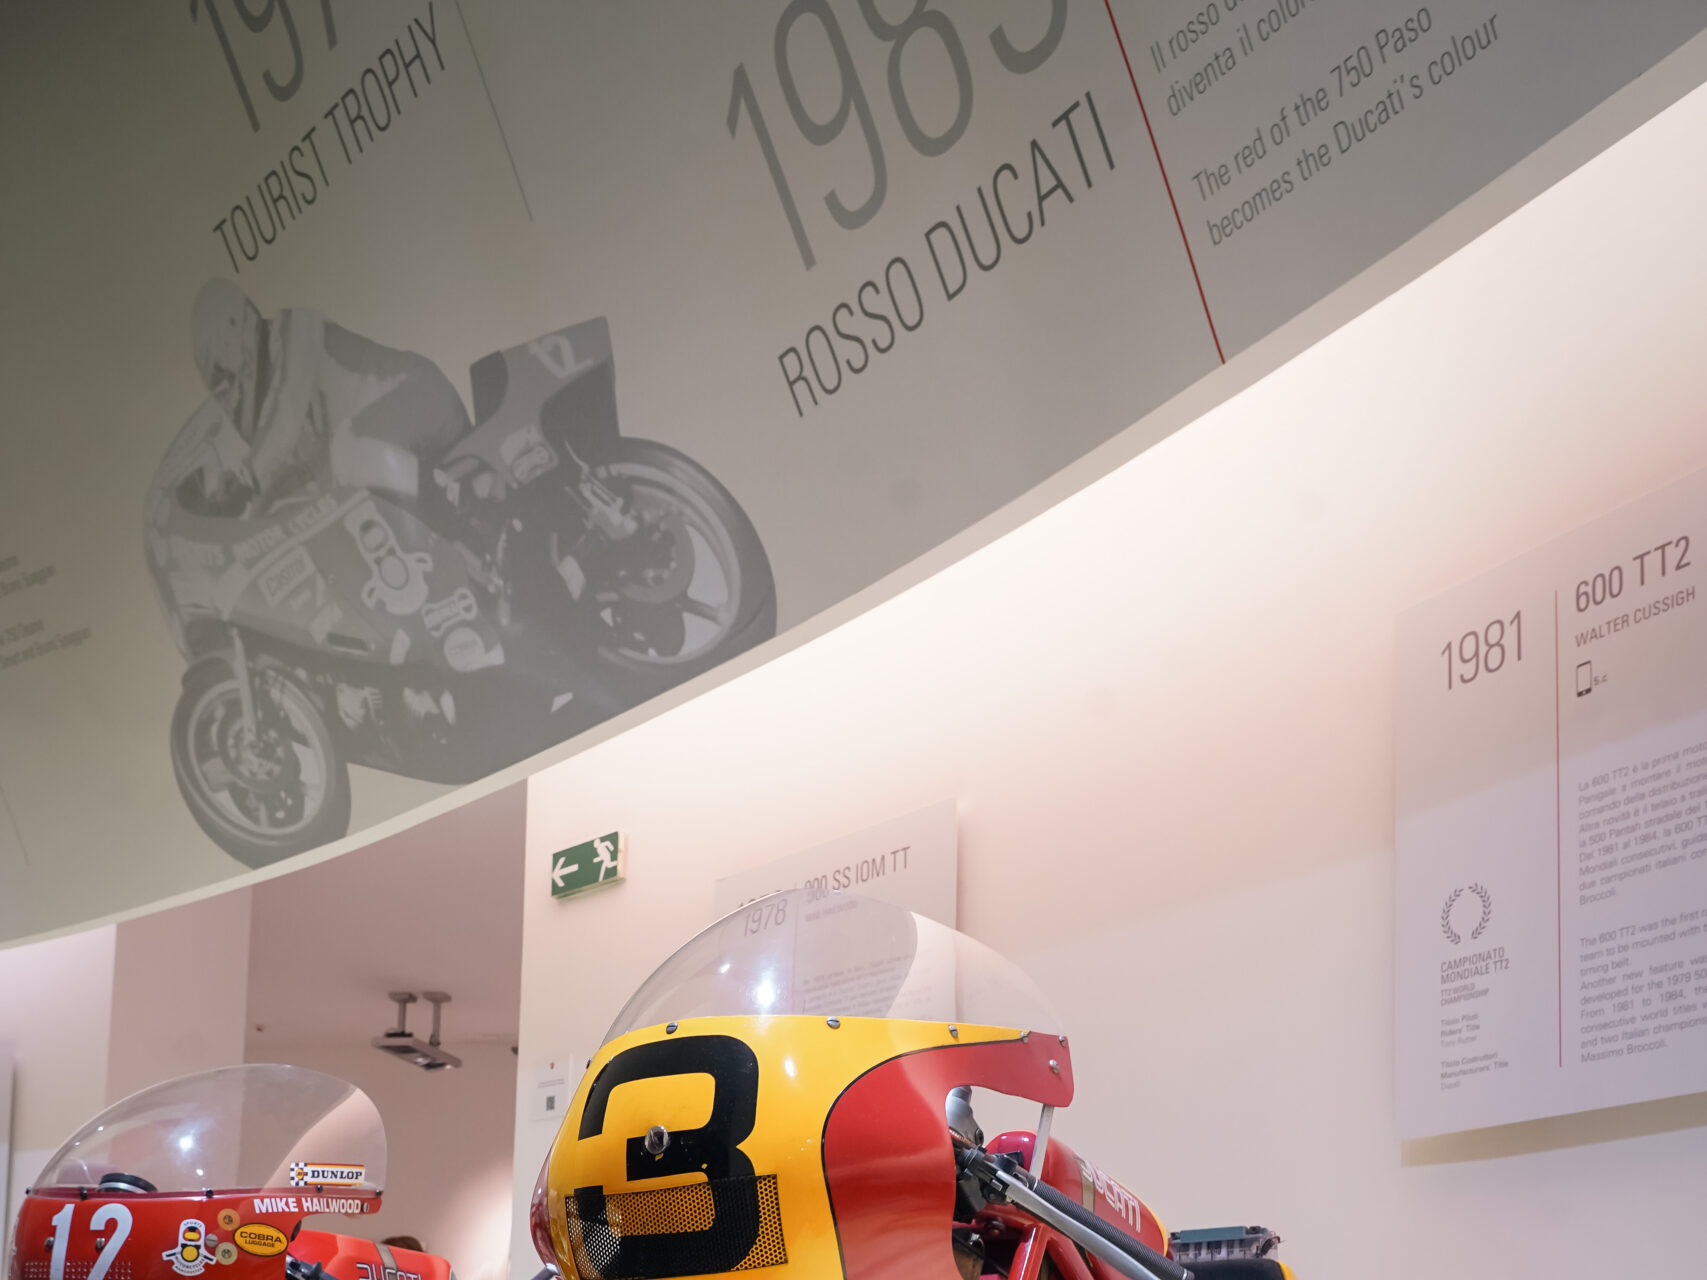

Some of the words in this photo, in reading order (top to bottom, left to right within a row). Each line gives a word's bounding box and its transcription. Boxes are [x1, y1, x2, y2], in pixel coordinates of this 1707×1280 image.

[1168, 3, 1220, 59] rosso
[1167, 47, 1236, 116] diventa
[1236, 23, 1254, 56] il
[1256, 0, 1312, 42] colo
[1192, 163, 1232, 201] The
[1234, 127, 1268, 174] red
[1270, 106, 1291, 145] of
[1294, 87, 1329, 127] the
[1329, 46, 1374, 97] 750
[1375, 7, 1432, 64] Paso
[212, 125, 330, 274] TOURIST
[323, 1, 446, 164] TROPHY
[1207, 170, 1294, 246] becomes
[1296, 143, 1332, 181] the
[1333, 74, 1424, 154] Ducati's
[1428, 14, 1498, 85] colour
[778, 256, 924, 417] ROSSO
[924, 91, 1115, 302] DUCATI
[1575, 565, 1623, 613] 600
[1632, 535, 1691, 586] TT2
[1574, 614, 1629, 648] WALTER
[1633, 586, 1696, 624] CUSSIGH
[1441, 609, 1522, 691] 1981
[1592, 774, 1609, 787] 600
[1613, 766, 1629, 780] TT2
[1652, 752, 1679, 768] prima
[1589, 832, 1606, 845] 500
[1674, 821, 1693, 834] 600
[832, 866, 851, 890] SS
[855, 855, 886, 884] IOM
[891, 846, 911, 872] TT
[744, 898, 787, 936] 1978
[1580, 937, 1597, 948] The
[1599, 930, 1616, 943] 600
[1619, 925, 1637, 938] TT2
[1639, 921, 1658, 933] was
[1661, 916, 1677, 928] the
[1679, 910, 1699, 923] first
[1441, 947, 1505, 973] CAMPIONATO
[1580, 951, 1604, 962] team
[1606, 947, 1616, 956] to
[1618, 943, 1629, 953] be
[1632, 931, 1676, 949] mounted
[1678, 924, 1700, 938] with
[1441, 962, 1490, 985] MONDIALE
[1493, 959, 1510, 973] TT2
[1580, 976, 1617, 991] Another
[1622, 970, 1644, 981] new
[1649, 960, 1684, 975] feature
[1580, 986, 1629, 1006] developed
[1631, 984, 1644, 994] for
[1647, 979, 1663, 990] the
[1667, 971, 1691, 986] 1979
[1580, 1008, 1605, 1020] From
[1612, 1000, 1634, 1013] 1981
[1642, 997, 1651, 1006] to
[1580, 1016, 1637, 1035] consecutive
[1640, 1008, 1669, 1022] world
[1581, 1038, 1598, 1049] and
[1600, 1034, 1618, 1045] two
[1622, 1027, 1650, 1040] Italian
[1581, 1049, 1623, 1063] Massimo
[310, 1169, 362, 1180] DUNLOP
[254, 1198, 298, 1213] MIKE
[302, 1197, 361, 1214] HAILWOOD
[1080, 1159, 1141, 1233] DUCATI
[240, 1231, 282, 1244] COBRA
[244, 1239, 275, 1248] LUGGAGE
